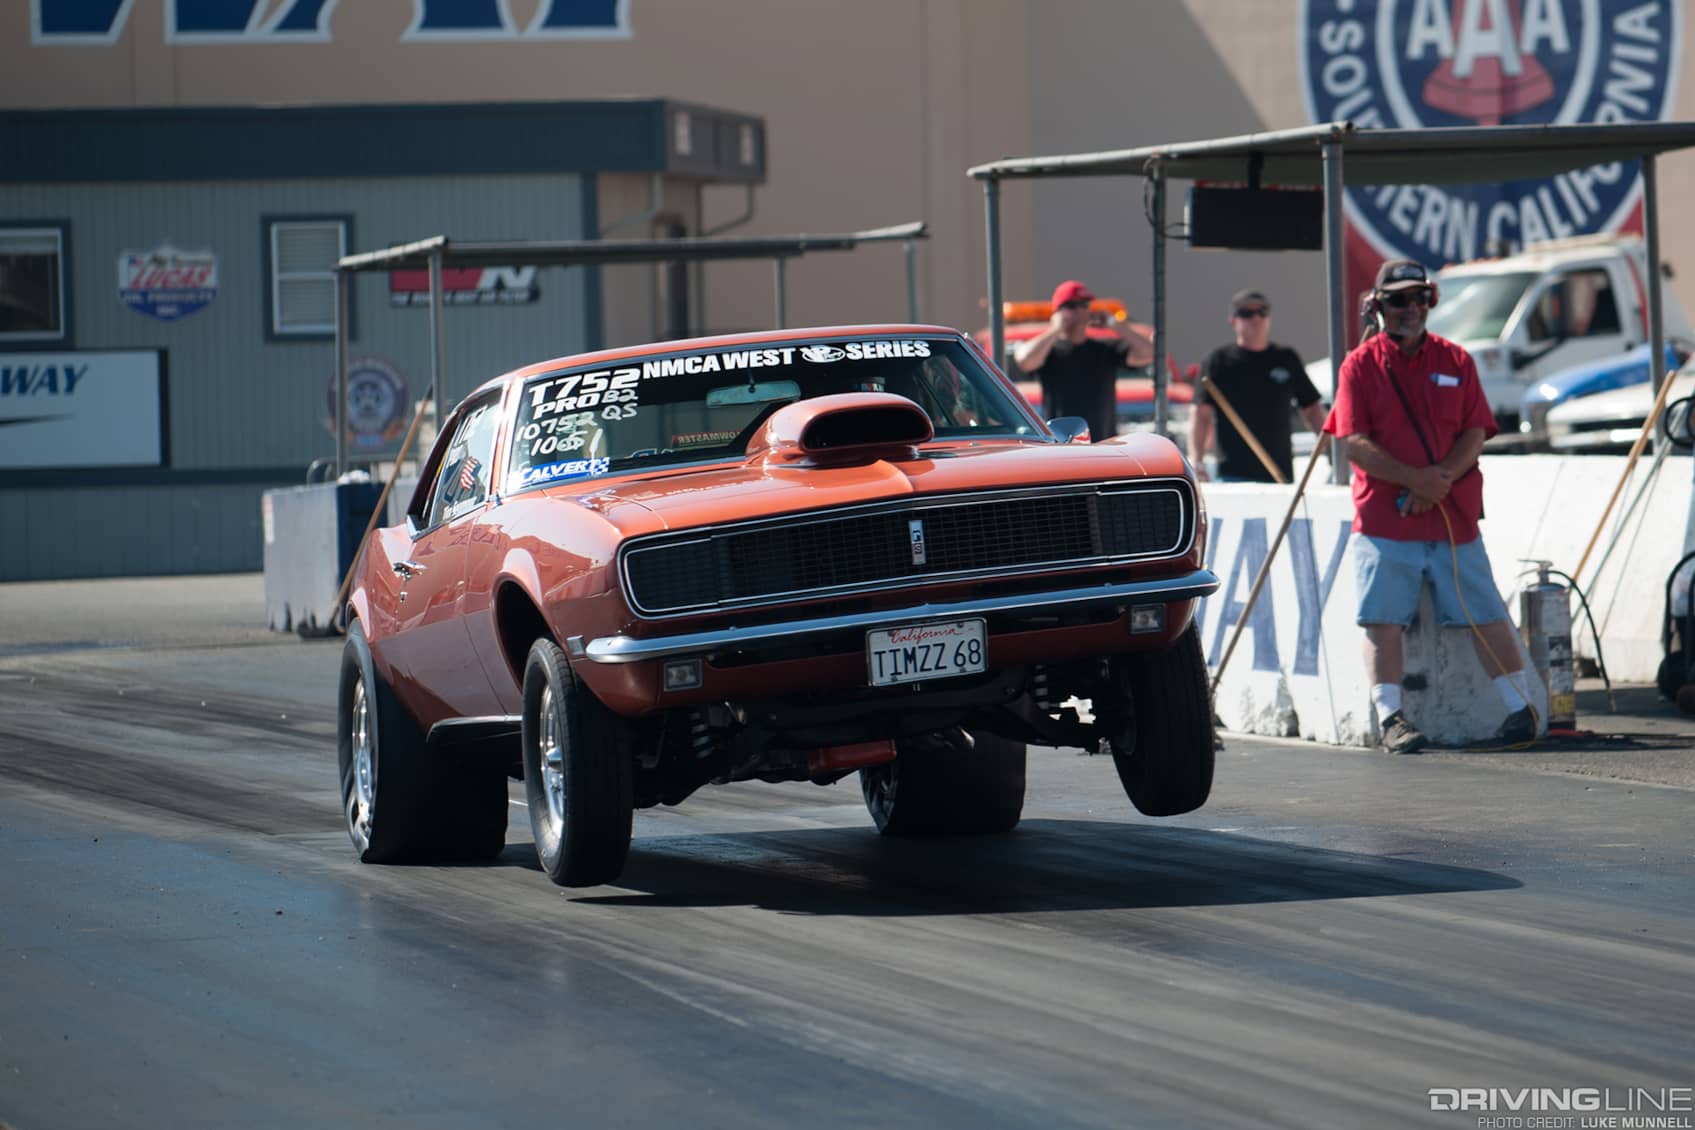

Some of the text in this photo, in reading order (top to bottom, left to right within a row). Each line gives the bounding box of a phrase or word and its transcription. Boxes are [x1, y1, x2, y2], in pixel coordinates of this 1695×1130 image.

[1405, 0, 1570, 78] AAA
[643, 355, 721, 379] NMCA
[723, 347, 796, 370] WEST
[845, 340, 931, 360] SERIES
[0, 363, 89, 396] WAY
[528, 368, 640, 407] T752
[533, 392, 600, 420] PRO
[1196, 518, 1352, 676] AY
[890, 625, 961, 644] California
[874, 638, 982, 678] TIMZZ 68
